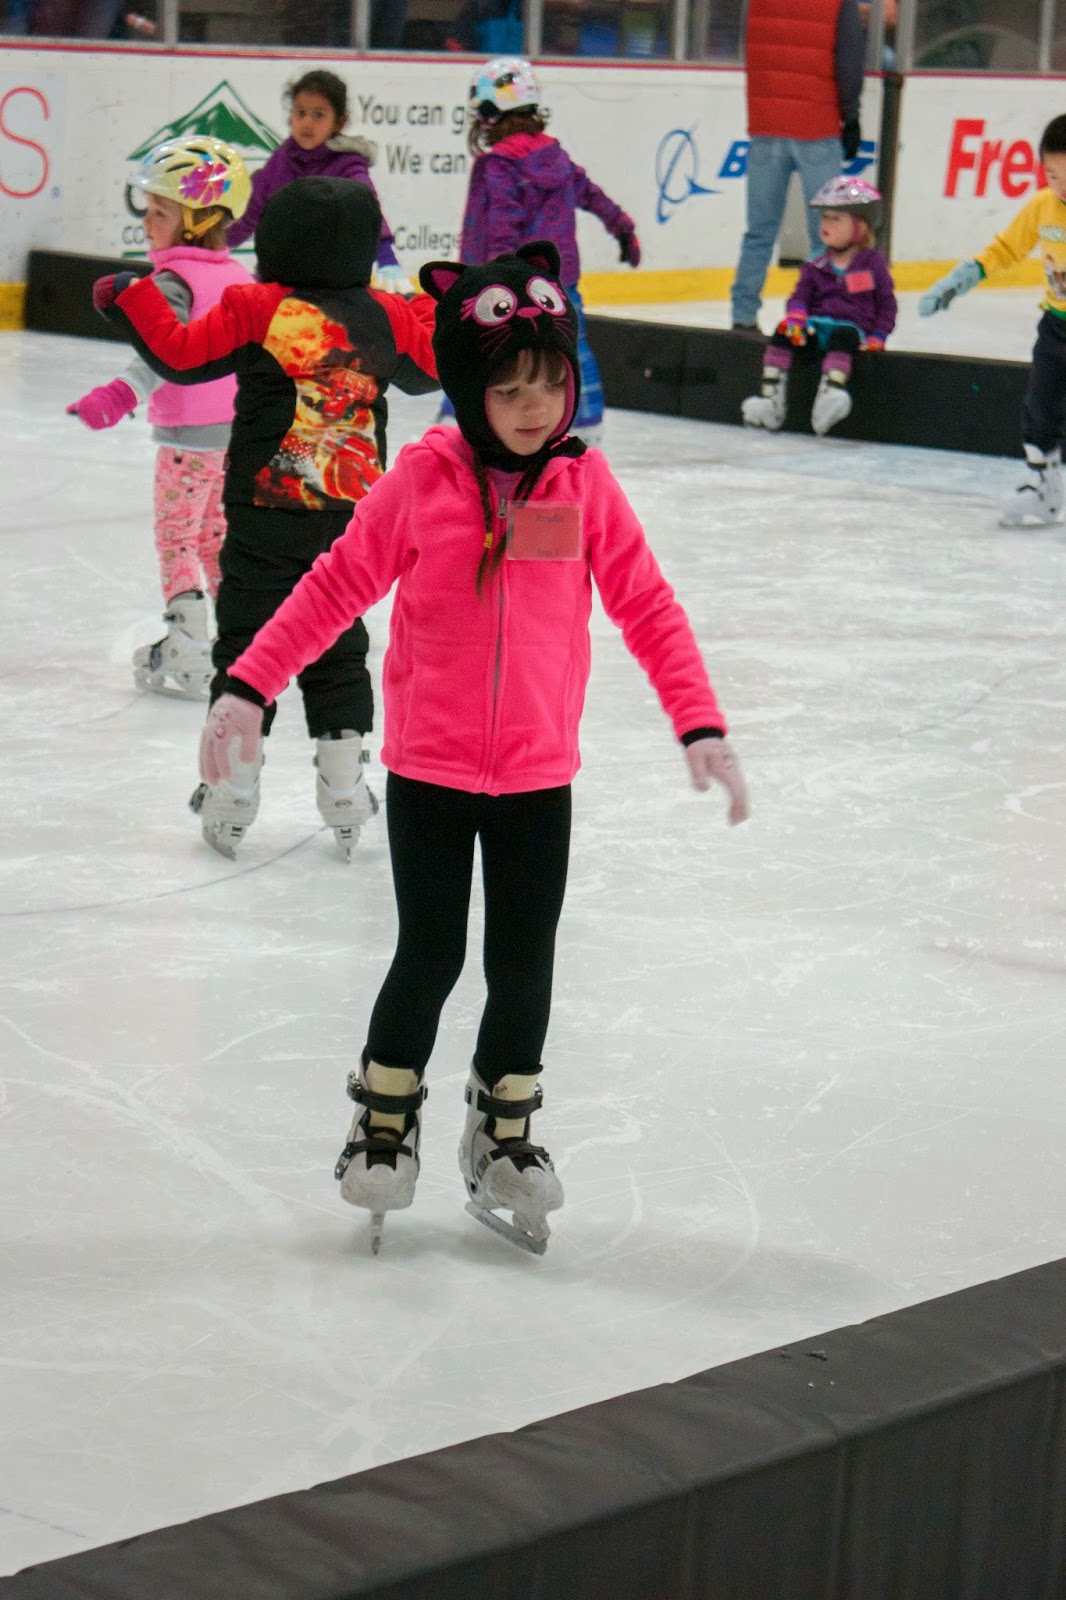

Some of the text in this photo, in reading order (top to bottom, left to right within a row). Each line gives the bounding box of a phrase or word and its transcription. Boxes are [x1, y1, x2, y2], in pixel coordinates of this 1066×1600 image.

[358, 95, 398, 126] You
[406, 103, 444, 126] can
[386, 143, 466, 174] We can
